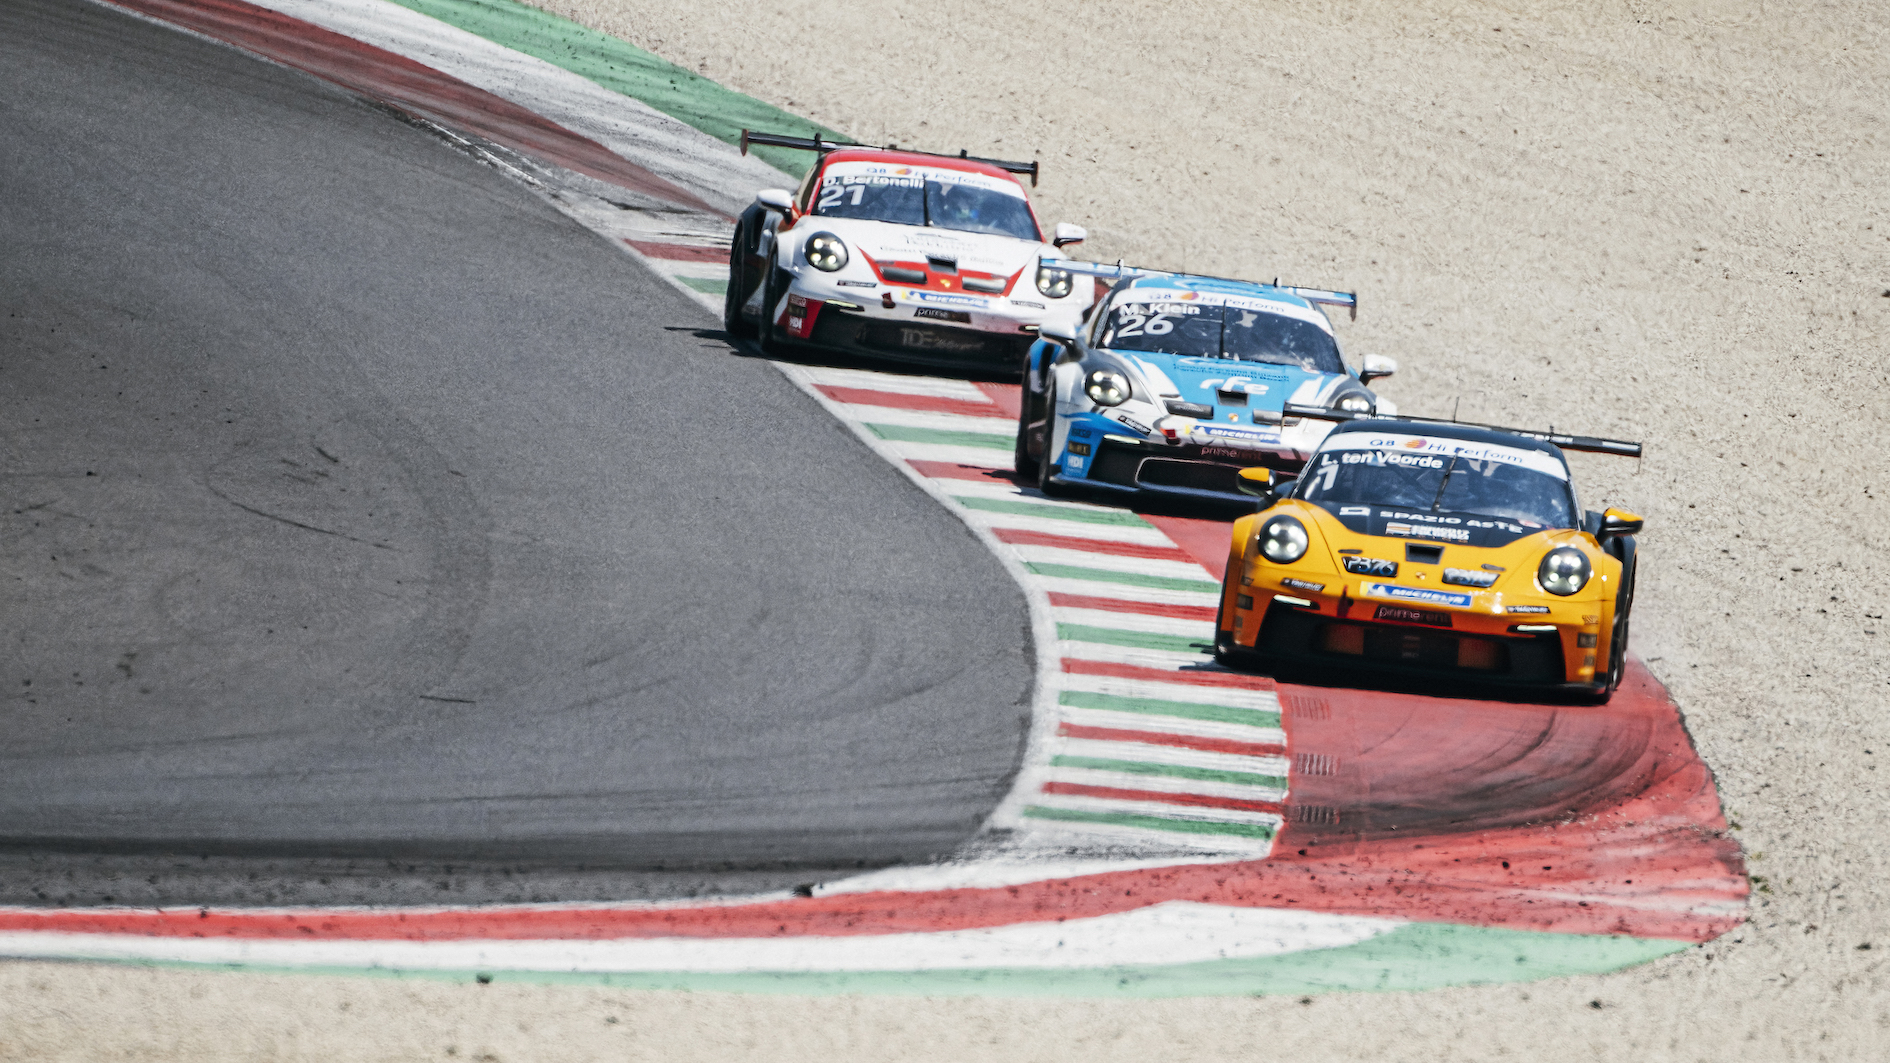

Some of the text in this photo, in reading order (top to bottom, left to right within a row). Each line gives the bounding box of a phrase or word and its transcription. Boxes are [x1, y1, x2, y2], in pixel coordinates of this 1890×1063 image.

[843, 176, 925, 189] Bertonelli
[818, 184, 866, 209] 21
[1118, 303, 1201, 316] M. Klein
[1224, 298, 1285, 313] Perform
[1117, 314, 1174, 338] 26
[1209, 428, 1277, 441] MICHELIN
[1320, 451, 1444, 469] L. ten Voorde
[1369, 439, 1523, 464] Q8 Hi Perform
[1317, 464, 1340, 491] 1
[1380, 510, 1523, 534] SPAZIO ASTE
[1391, 588, 1466, 605] MICHELIN
